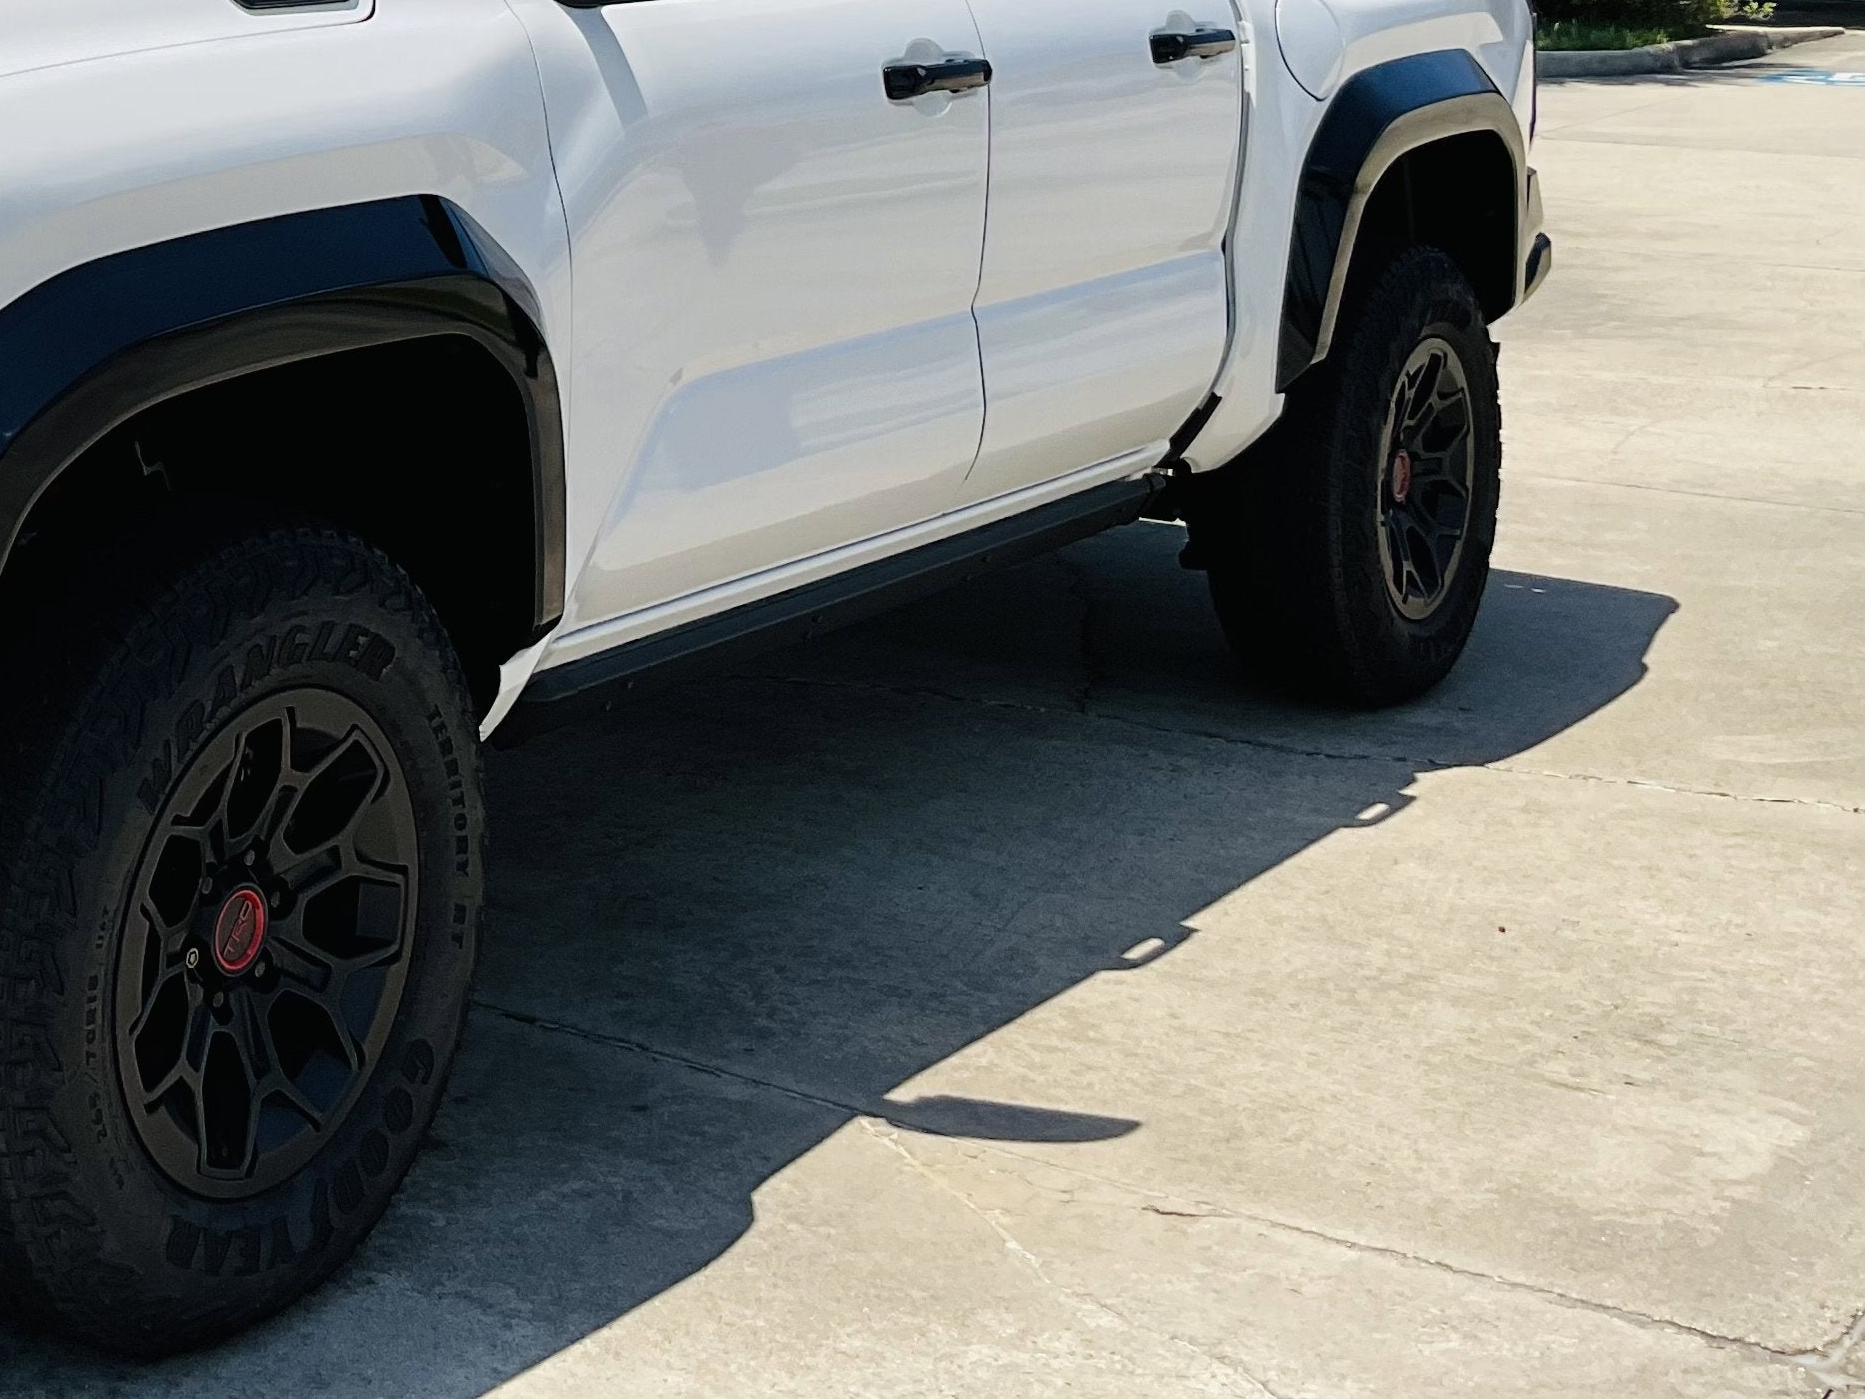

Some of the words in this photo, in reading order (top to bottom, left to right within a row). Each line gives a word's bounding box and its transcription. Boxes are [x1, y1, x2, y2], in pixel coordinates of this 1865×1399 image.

[136, 620, 396, 815] WRANGLER
[427, 704, 469, 877] TERRITORY
[223, 899, 253, 958] TRD
[166, 1038, 435, 1277] GOODYEAR
